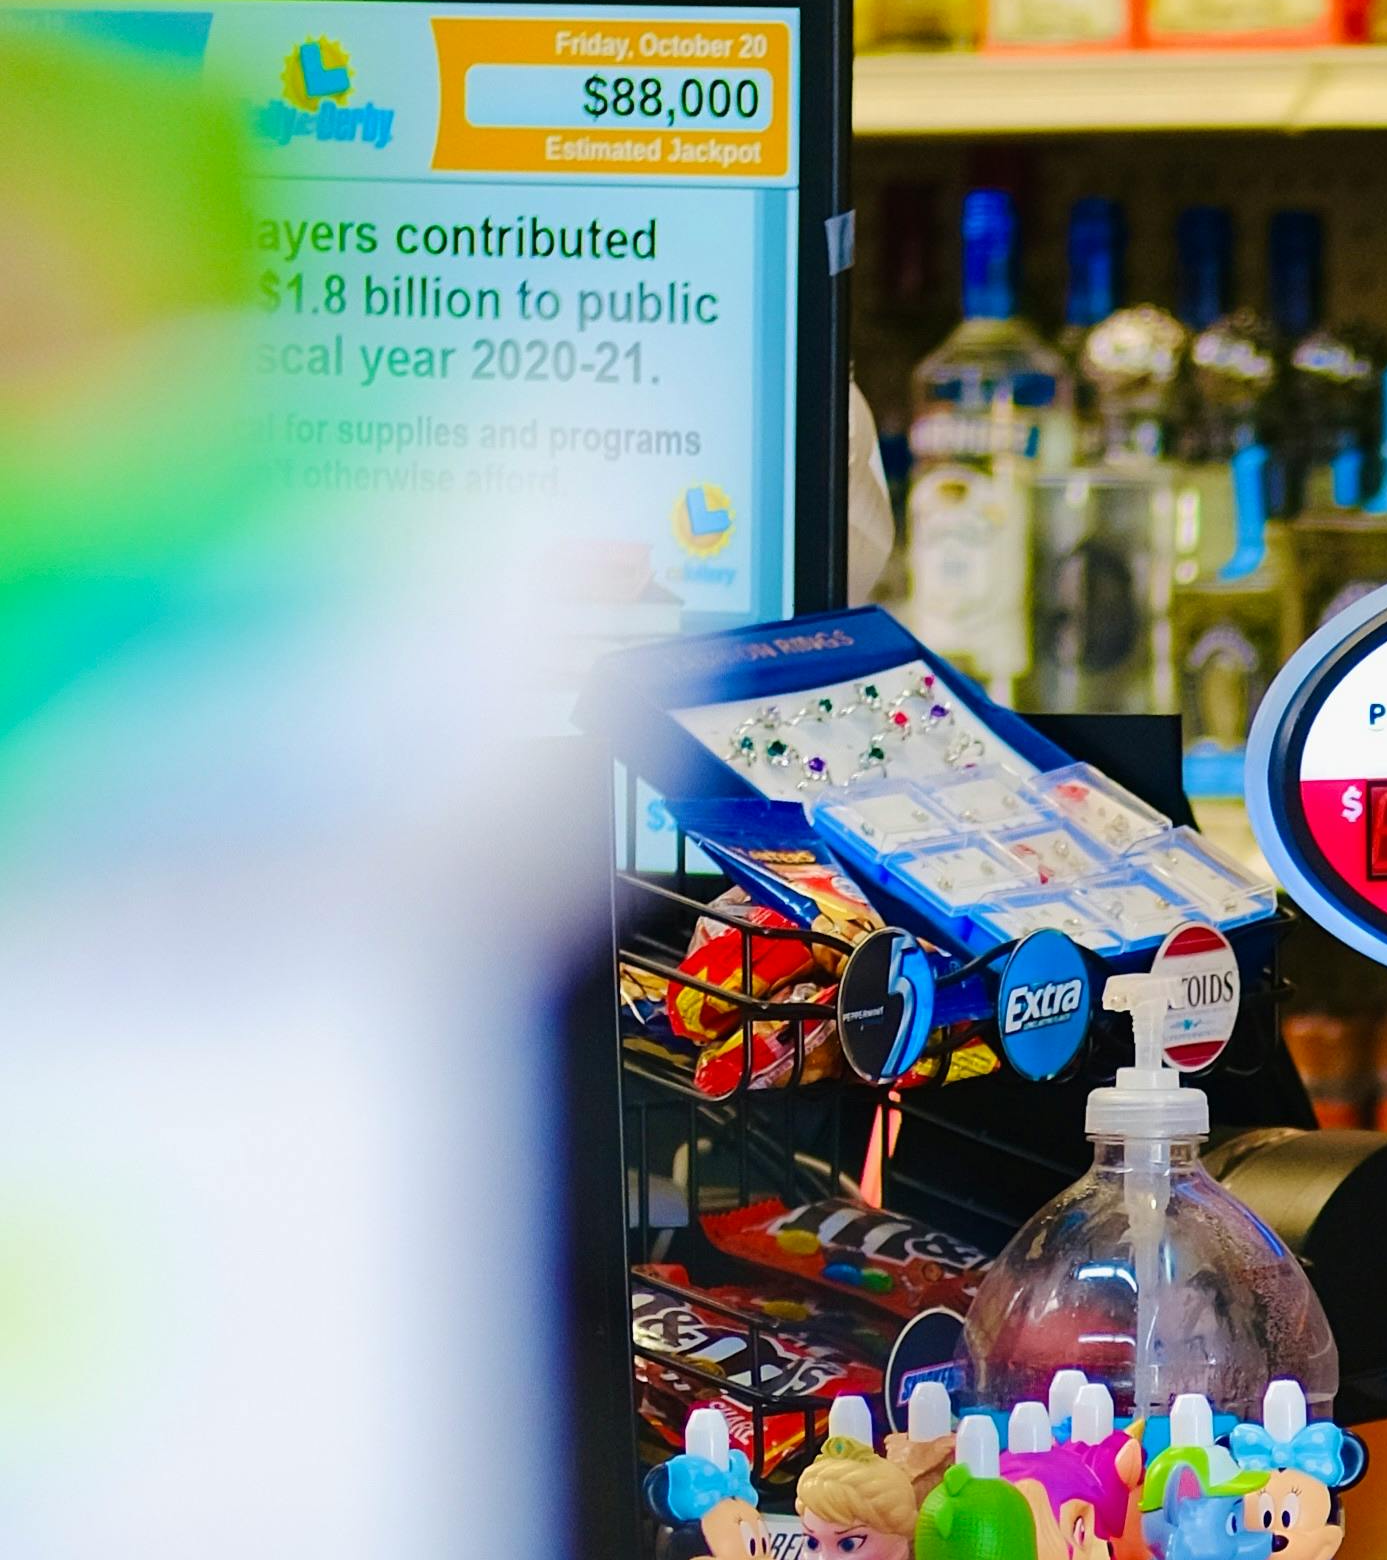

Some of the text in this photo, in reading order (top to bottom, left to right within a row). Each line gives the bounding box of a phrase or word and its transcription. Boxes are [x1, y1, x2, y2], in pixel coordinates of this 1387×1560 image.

[556, 31, 768, 61] Friday, October 20
[584, 73, 760, 127] $88,000
[544, 136, 763, 168] Estimated Jackpot
[257, 215, 658, 262] ayers contributed
[259, 271, 721, 332] $1.8 billion to public
[360, 338, 661, 388] year 2020-21.
[284, 414, 702, 460] for supplies and programs
[1342, 785, 1364, 823] $
[1004, 976, 1083, 1034] Extra
